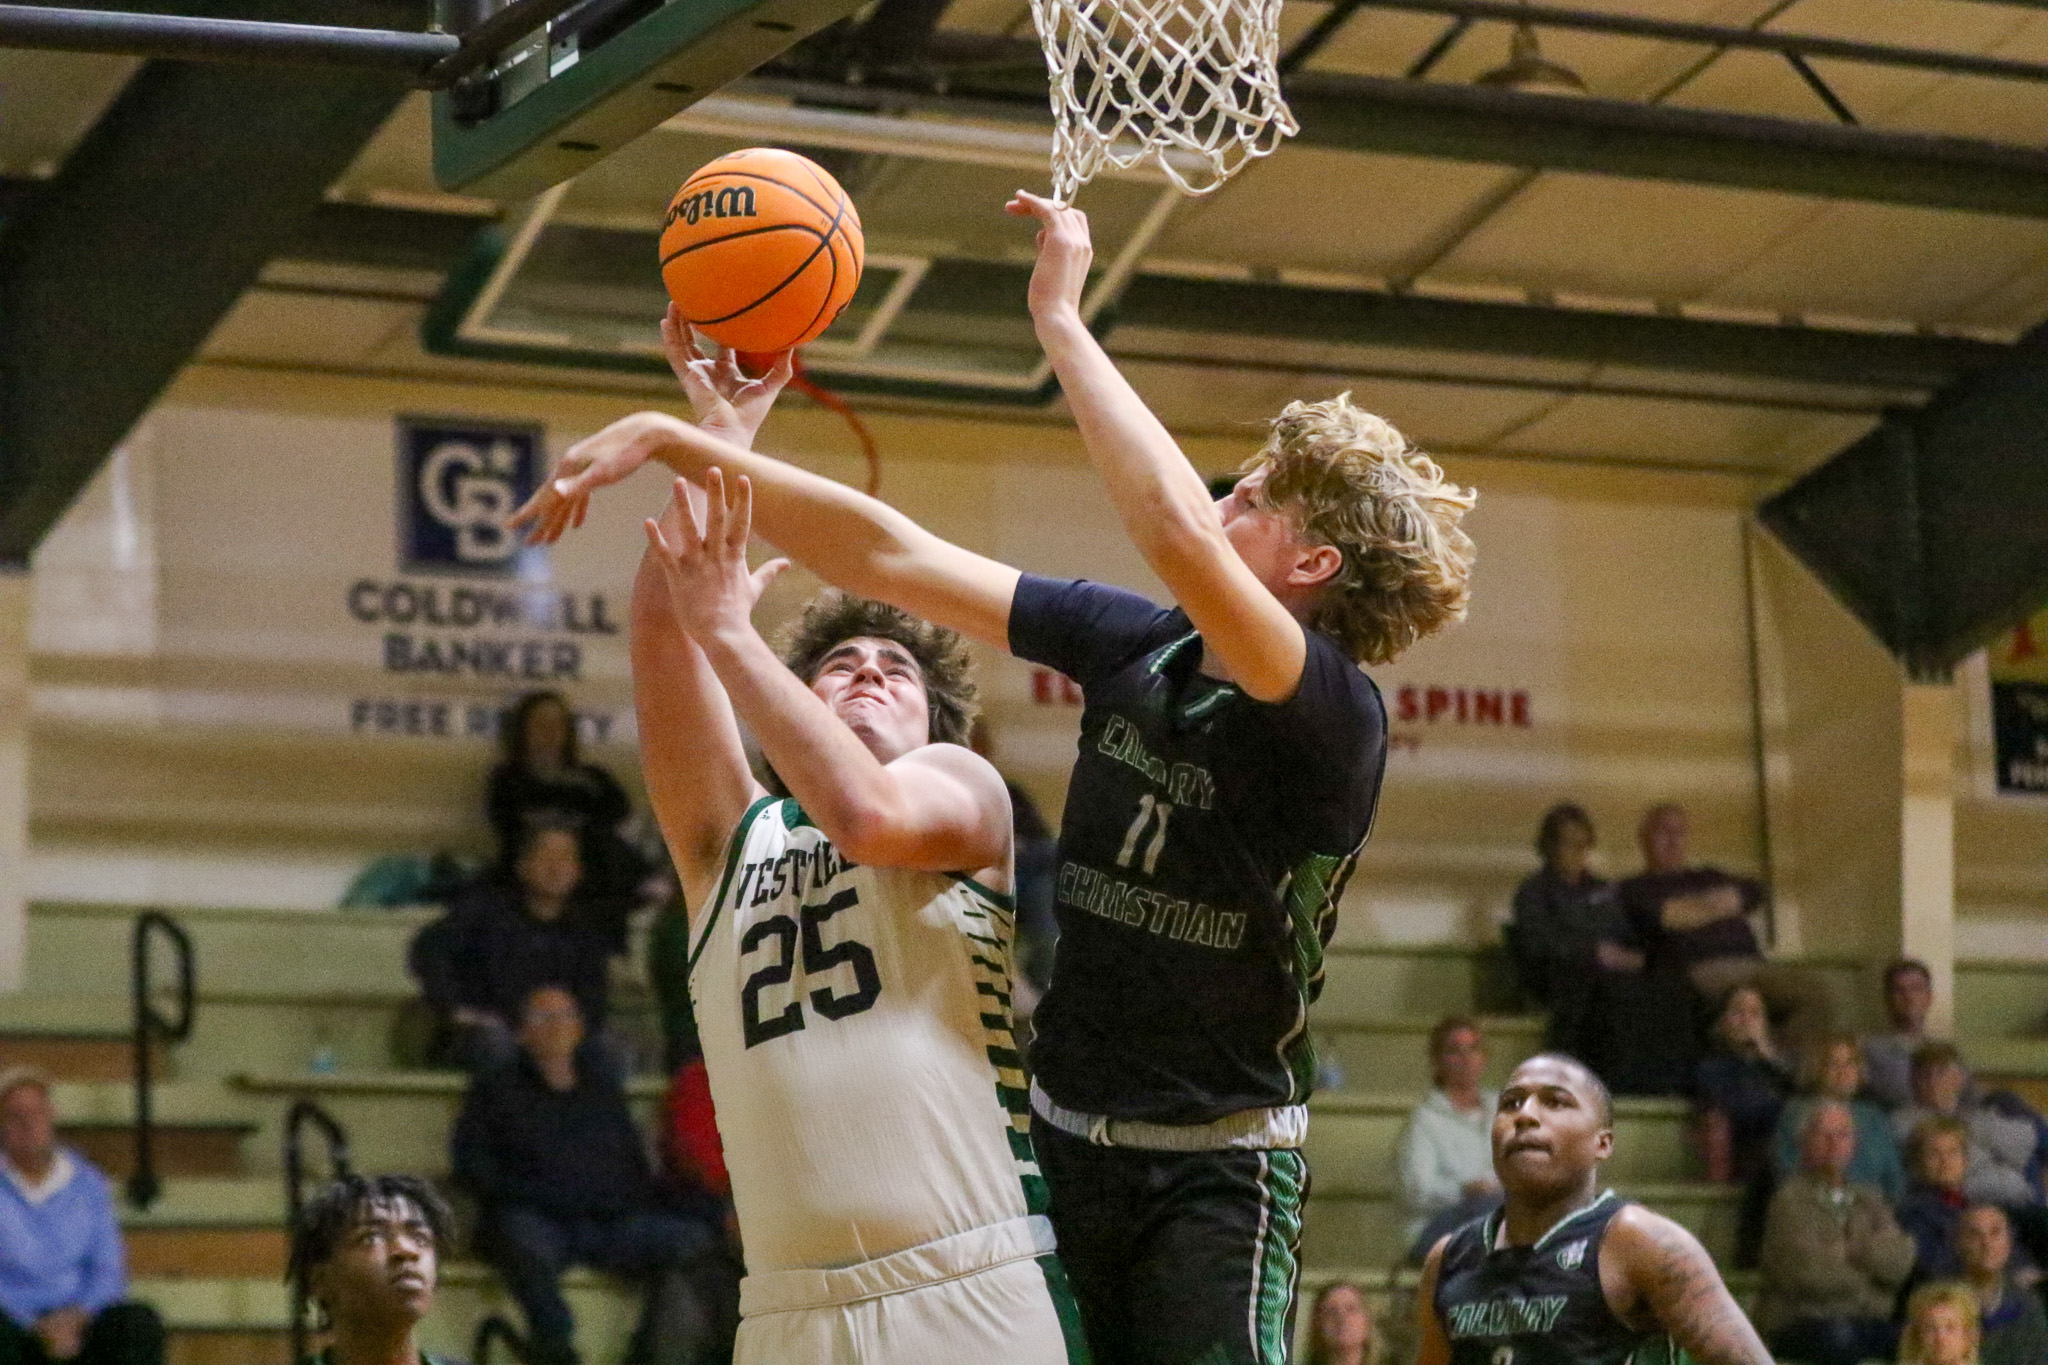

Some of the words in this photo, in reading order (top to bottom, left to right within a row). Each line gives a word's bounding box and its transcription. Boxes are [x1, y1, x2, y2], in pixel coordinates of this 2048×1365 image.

[663, 187, 757, 232] Wilso
[348, 579, 618, 635] COLDWLL
[383, 633, 582, 678] BANKER
[351, 701, 448, 737] FREE
[1397, 684, 1531, 727] SPINE
[1097, 714, 1216, 809] CALARY
[1116, 793, 1173, 875] 11
[735, 841, 859, 910] ESTIE
[1058, 862, 1247, 949] CHRISTIAN
[741, 887, 882, 1050] 25
